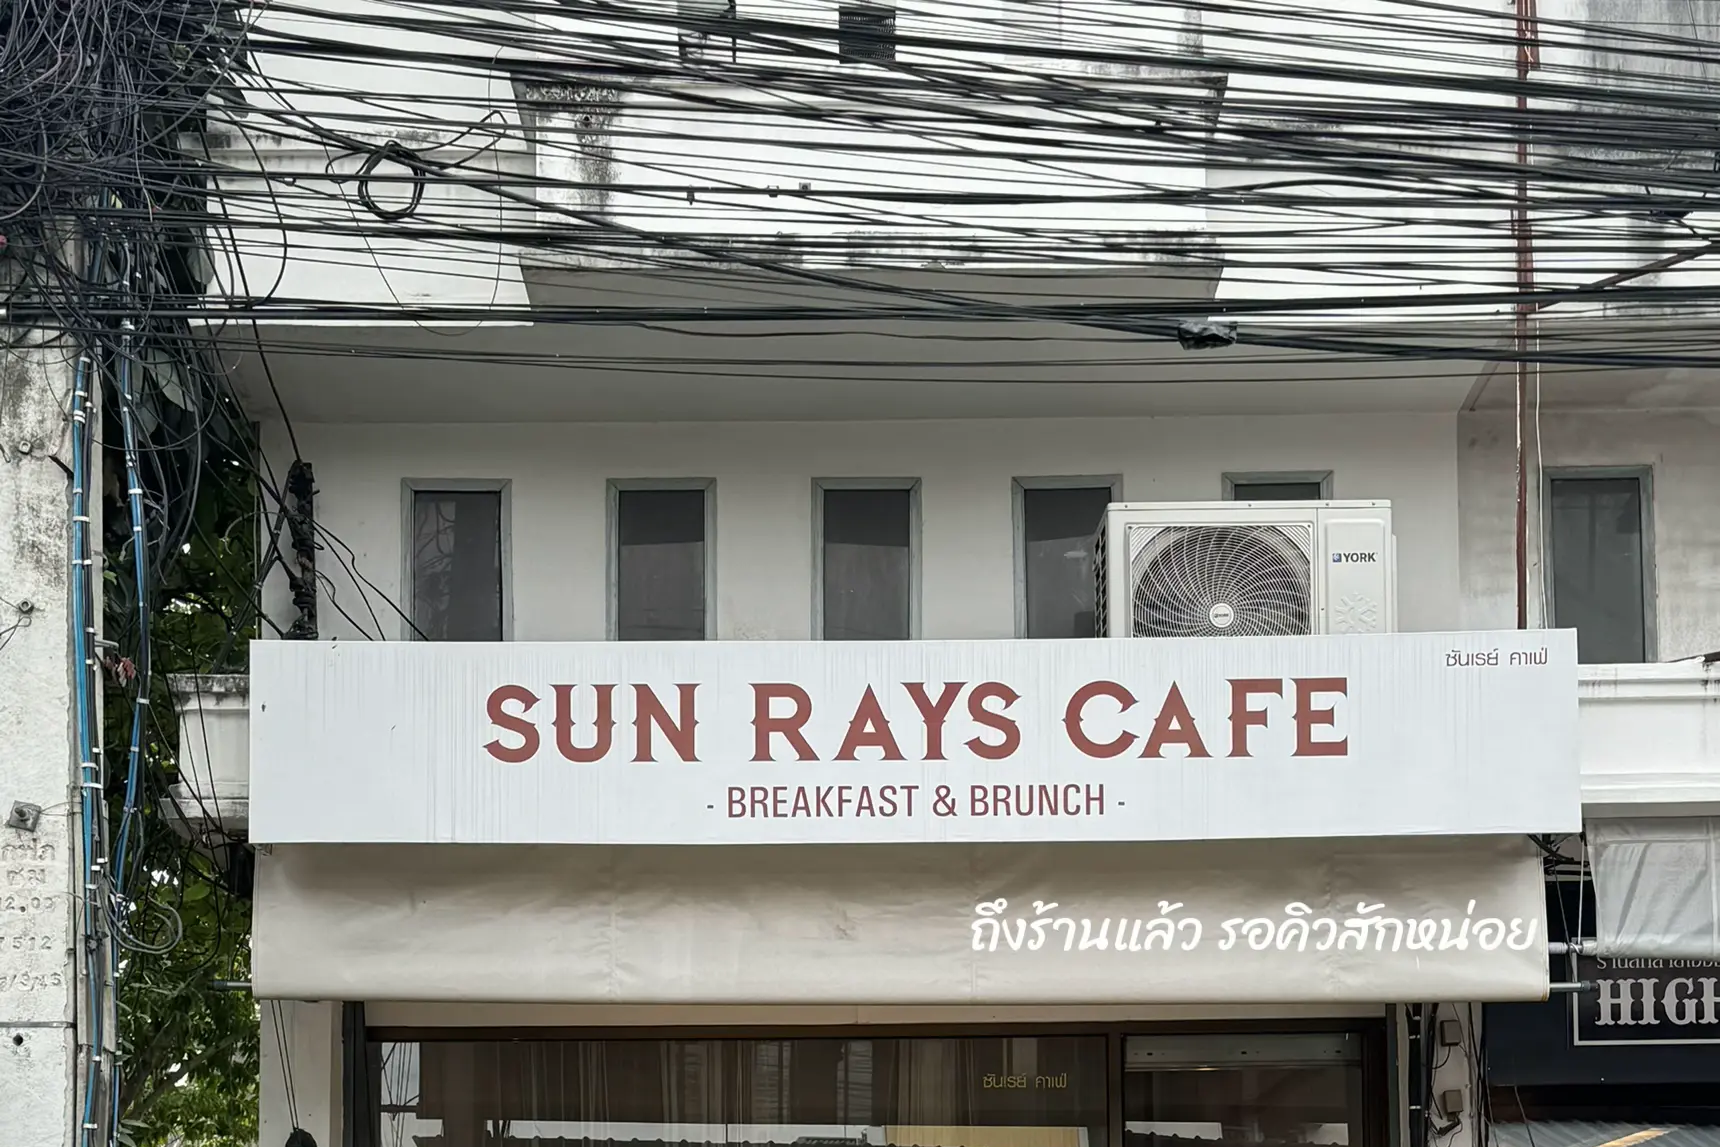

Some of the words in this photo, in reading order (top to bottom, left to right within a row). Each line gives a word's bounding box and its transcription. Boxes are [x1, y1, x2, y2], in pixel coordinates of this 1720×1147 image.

[1343, 552, 1376, 563] YORK
[482, 682, 702, 763] SUN
[747, 680, 1022, 762] RAYS
[1061, 677, 1348, 759] CAFE
[727, 784, 919, 819] BREAKFAST
[931, 785, 959, 818] &
[969, 783, 1106, 816] BRUNCH
